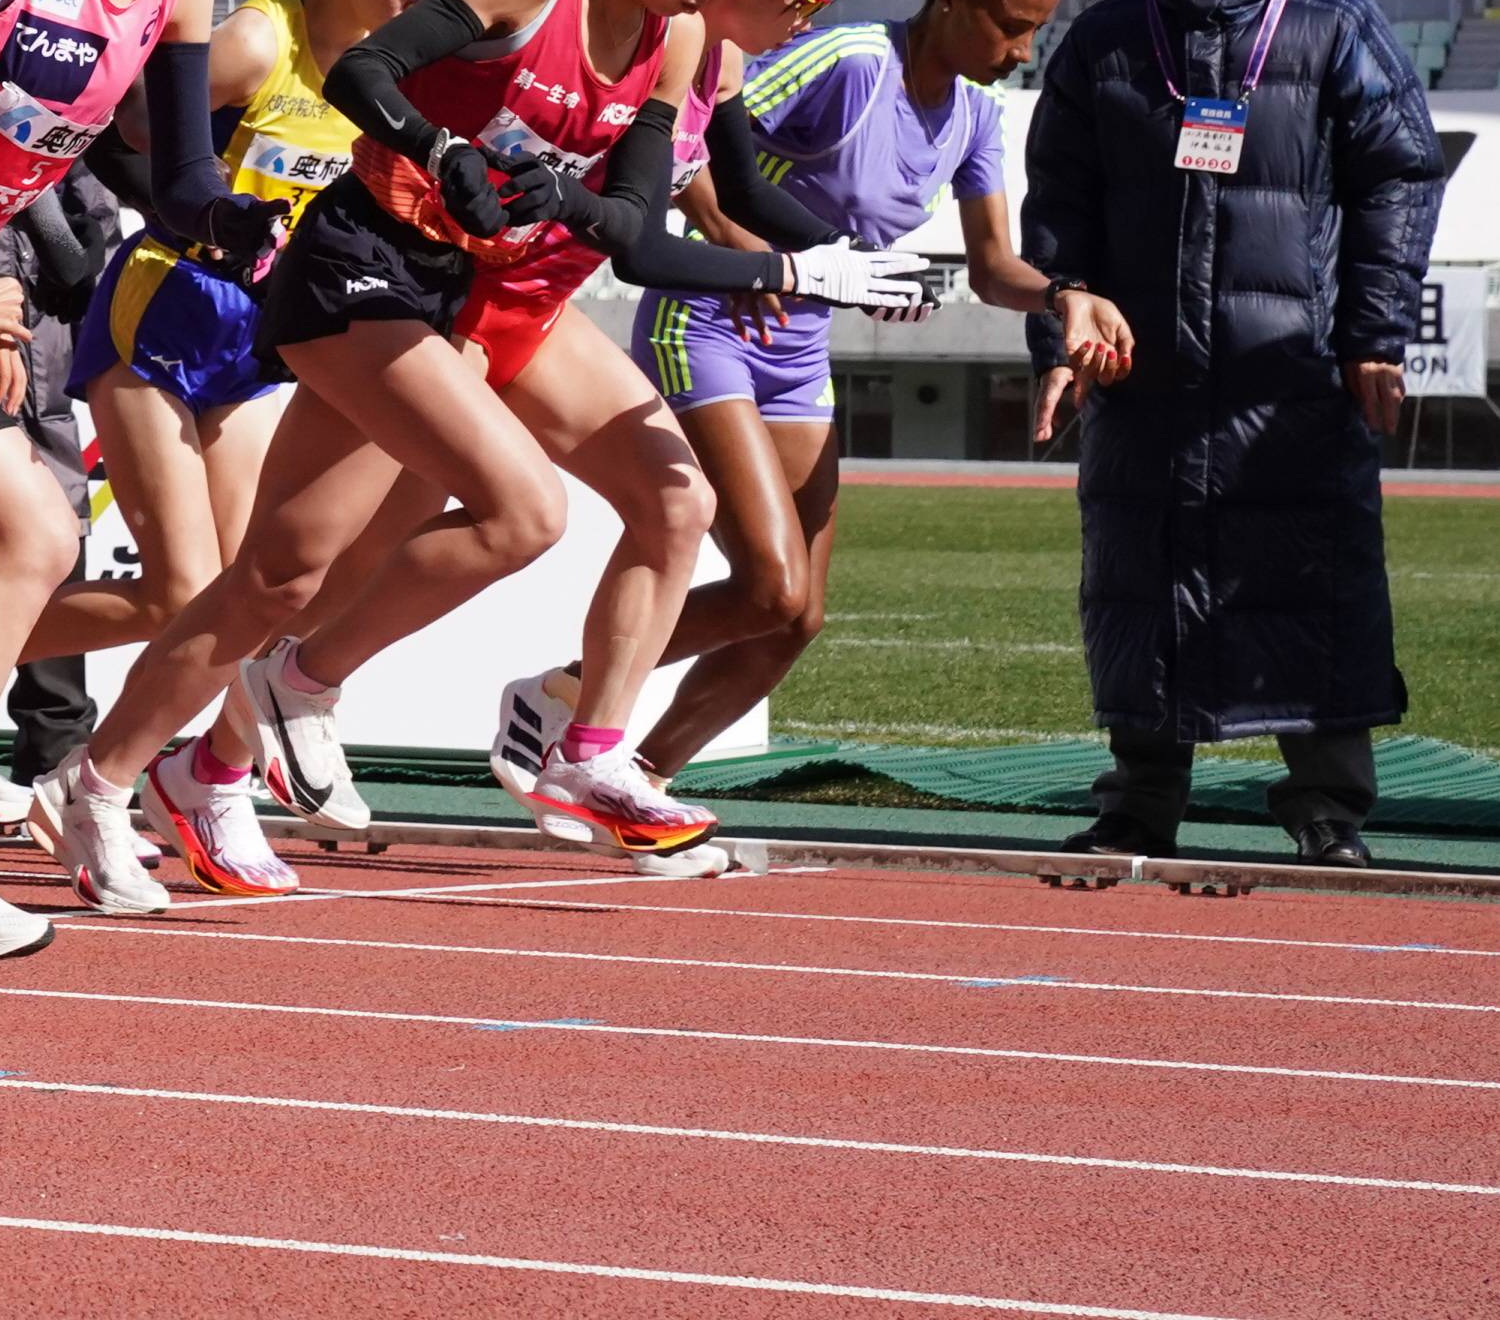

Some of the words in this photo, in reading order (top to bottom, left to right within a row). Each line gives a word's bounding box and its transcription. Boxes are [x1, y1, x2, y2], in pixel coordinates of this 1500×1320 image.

[15, 22, 99, 67] てんまや
[514, 67, 581, 110] 第一生命
[32, 125, 98, 156] 奥村
[22, 161, 51, 185] 5
[288, 155, 349, 181] 奥村
